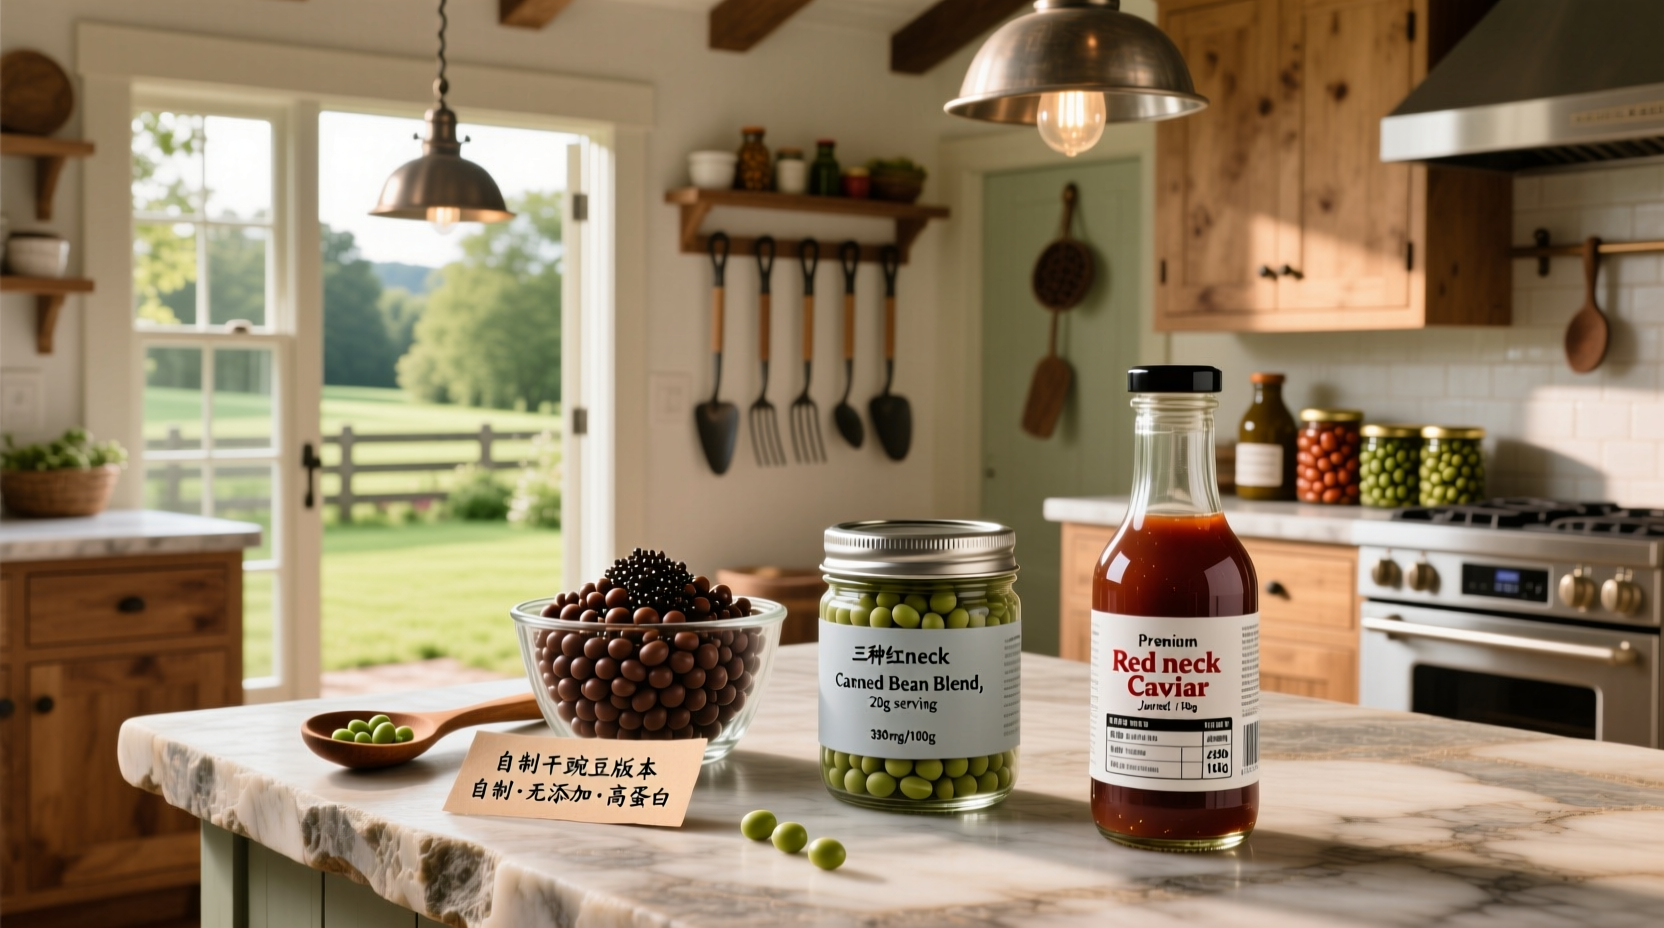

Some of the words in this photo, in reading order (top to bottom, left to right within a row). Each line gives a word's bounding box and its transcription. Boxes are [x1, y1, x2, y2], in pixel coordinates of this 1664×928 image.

[851, 643, 951, 666] 三种红neck
[1112, 648, 1157, 674] Red
[1161, 650, 1222, 674] neck
[888, 675, 929, 692] Bean
[932, 673, 984, 695] Blend,
[1127, 674, 1210, 697] Caviar
[869, 695, 892, 713] 20g
[893, 696, 938, 714] serving
[496, 750, 658, 781] 自制干豌豆版本
